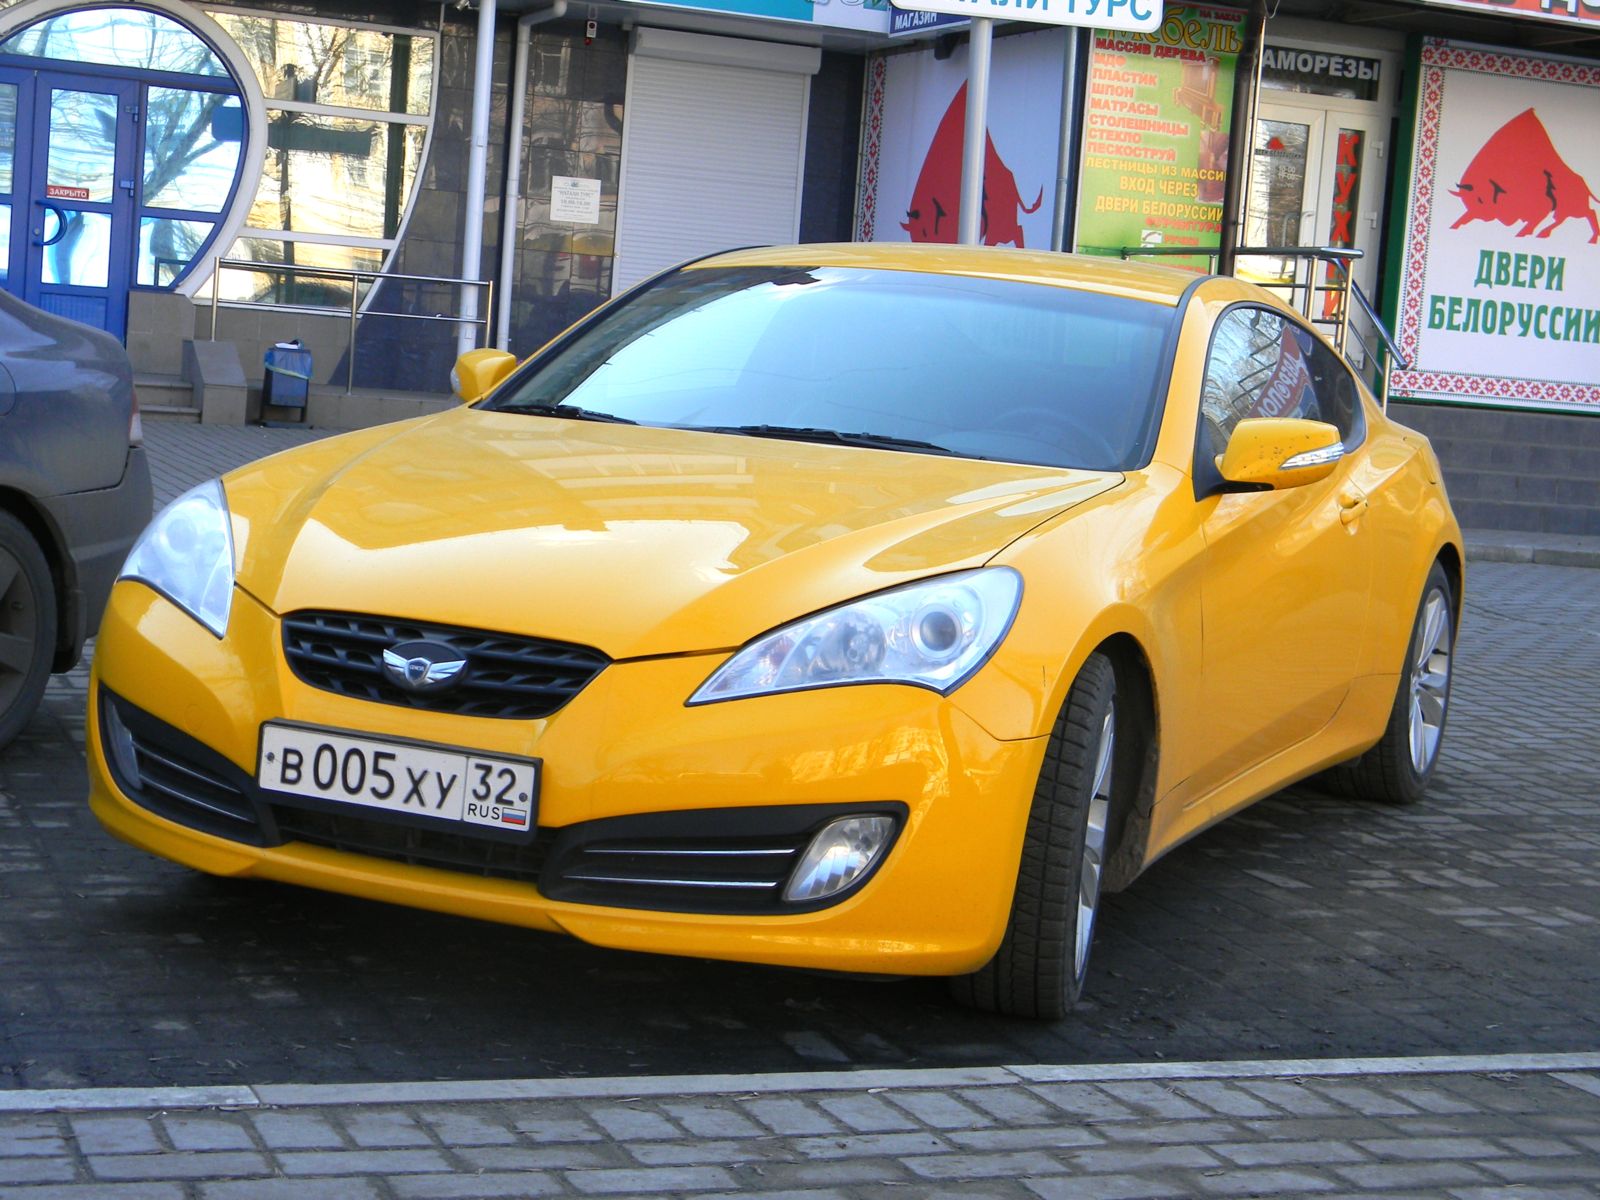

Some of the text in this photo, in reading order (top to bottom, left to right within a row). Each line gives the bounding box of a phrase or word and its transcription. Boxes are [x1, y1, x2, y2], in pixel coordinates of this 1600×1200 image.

[1095, 38, 1206, 62] МАССИВ ДЕРЕВА
[1092, 68, 1157, 85] ПЛАСТИК
[1091, 83, 1134, 98] ШПОН
[1090, 98, 1158, 116] МАТРАСЫ
[1088, 113, 1188, 136] СТОЛЕШНИЦЫ
[1087, 128, 1142, 144] СТЕКЛО
[1086, 142, 1177, 161] ПЕСКОСТРУЙ
[1086, 157, 1226, 182] ЛЕСТНИЦЫ ИЗ МАССИ
[49, 188, 87, 197] ЗАКРЫТО
[1120, 176, 1199, 198] ВХОД ЧЕРЕЗ
[1095, 195, 1223, 222] ДВЕРИ БЕЛОРУССИИ
[1474, 250, 1566, 291] ДВЕРИ
[1428, 295, 1600, 344] БЕЛОРУССИИ
[472, 763, 516, 806] 32
[468, 803, 500, 820] RUS
